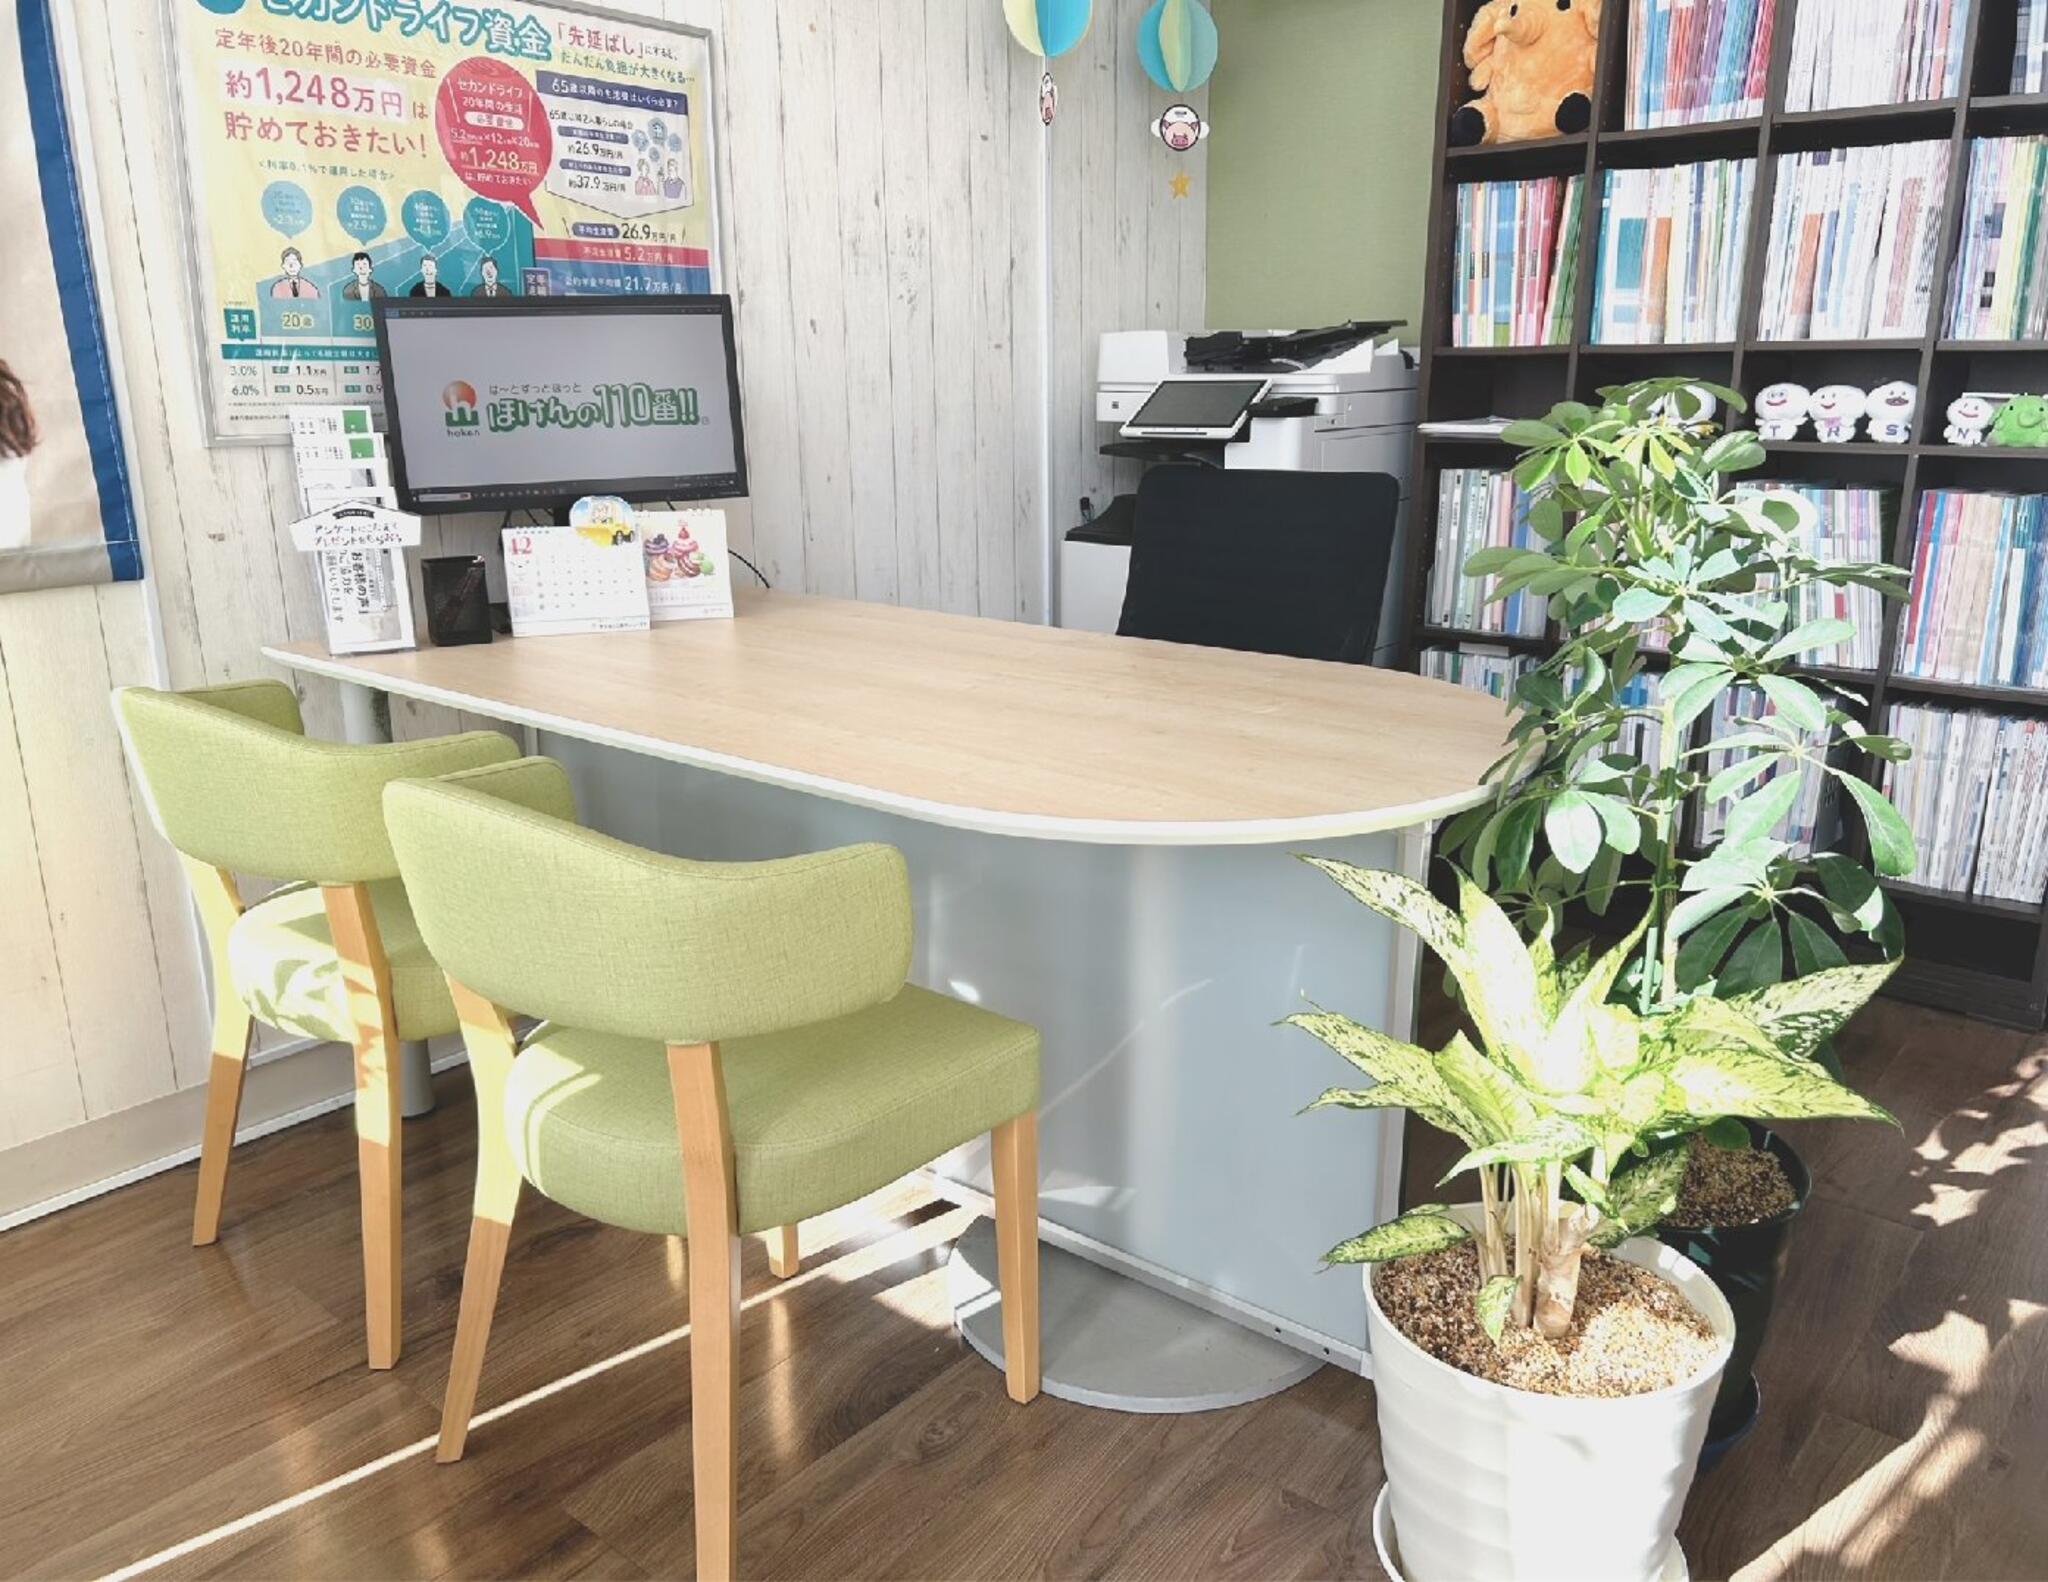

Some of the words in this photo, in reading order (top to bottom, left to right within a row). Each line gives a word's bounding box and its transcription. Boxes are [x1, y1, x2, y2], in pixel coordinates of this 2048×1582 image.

[215, 28, 437, 78] 定年後20年間の必要資金
[457, 78, 523, 98] セカンドライフ
[461, 147, 538, 174] 約1,248万円
[230, 366, 257, 376] 3.0%
[231, 385, 259, 396] 6.0%
[446, 428, 480, 437] hoken
[1769, 424, 1781, 437] T
[1827, 425, 1840, 437] R
[1886, 424, 1898, 436] S
[1957, 427, 1970, 439] N
[511, 537, 532, 555] 12
